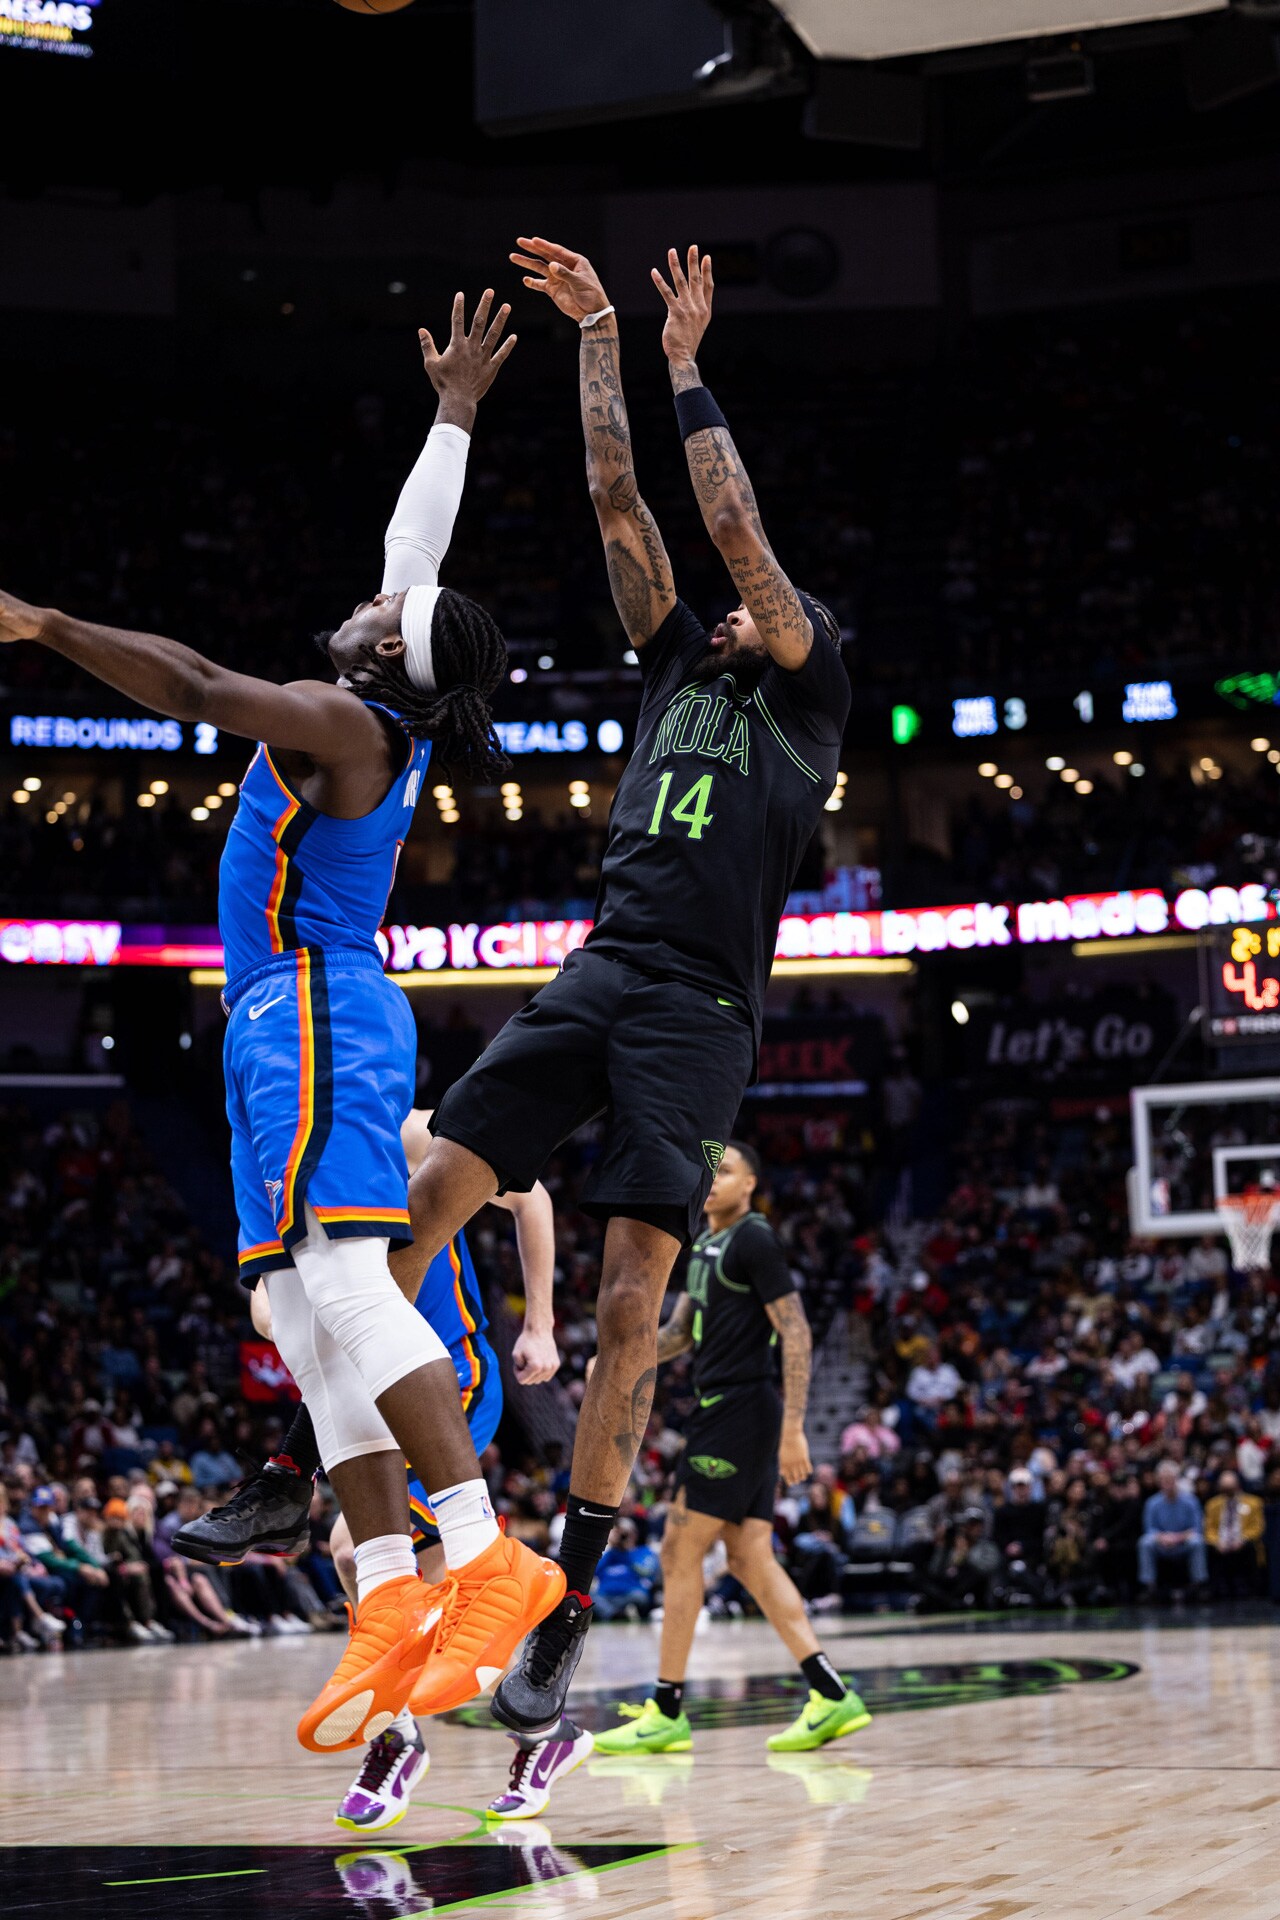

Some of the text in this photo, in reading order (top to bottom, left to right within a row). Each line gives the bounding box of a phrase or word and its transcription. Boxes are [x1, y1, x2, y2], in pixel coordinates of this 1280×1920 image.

[1004, 697, 1028, 730] 3
[1073, 690, 1094, 724] 1
[10, 714, 218, 754] REBOUNDS 2
[489, 719, 588, 754] TEALS
[649, 695, 750, 776] NOLA
[648, 771, 714, 839] 14
[775, 883, 1280, 957] ash back made eas
[986, 1014, 1153, 1065] Let's Go
